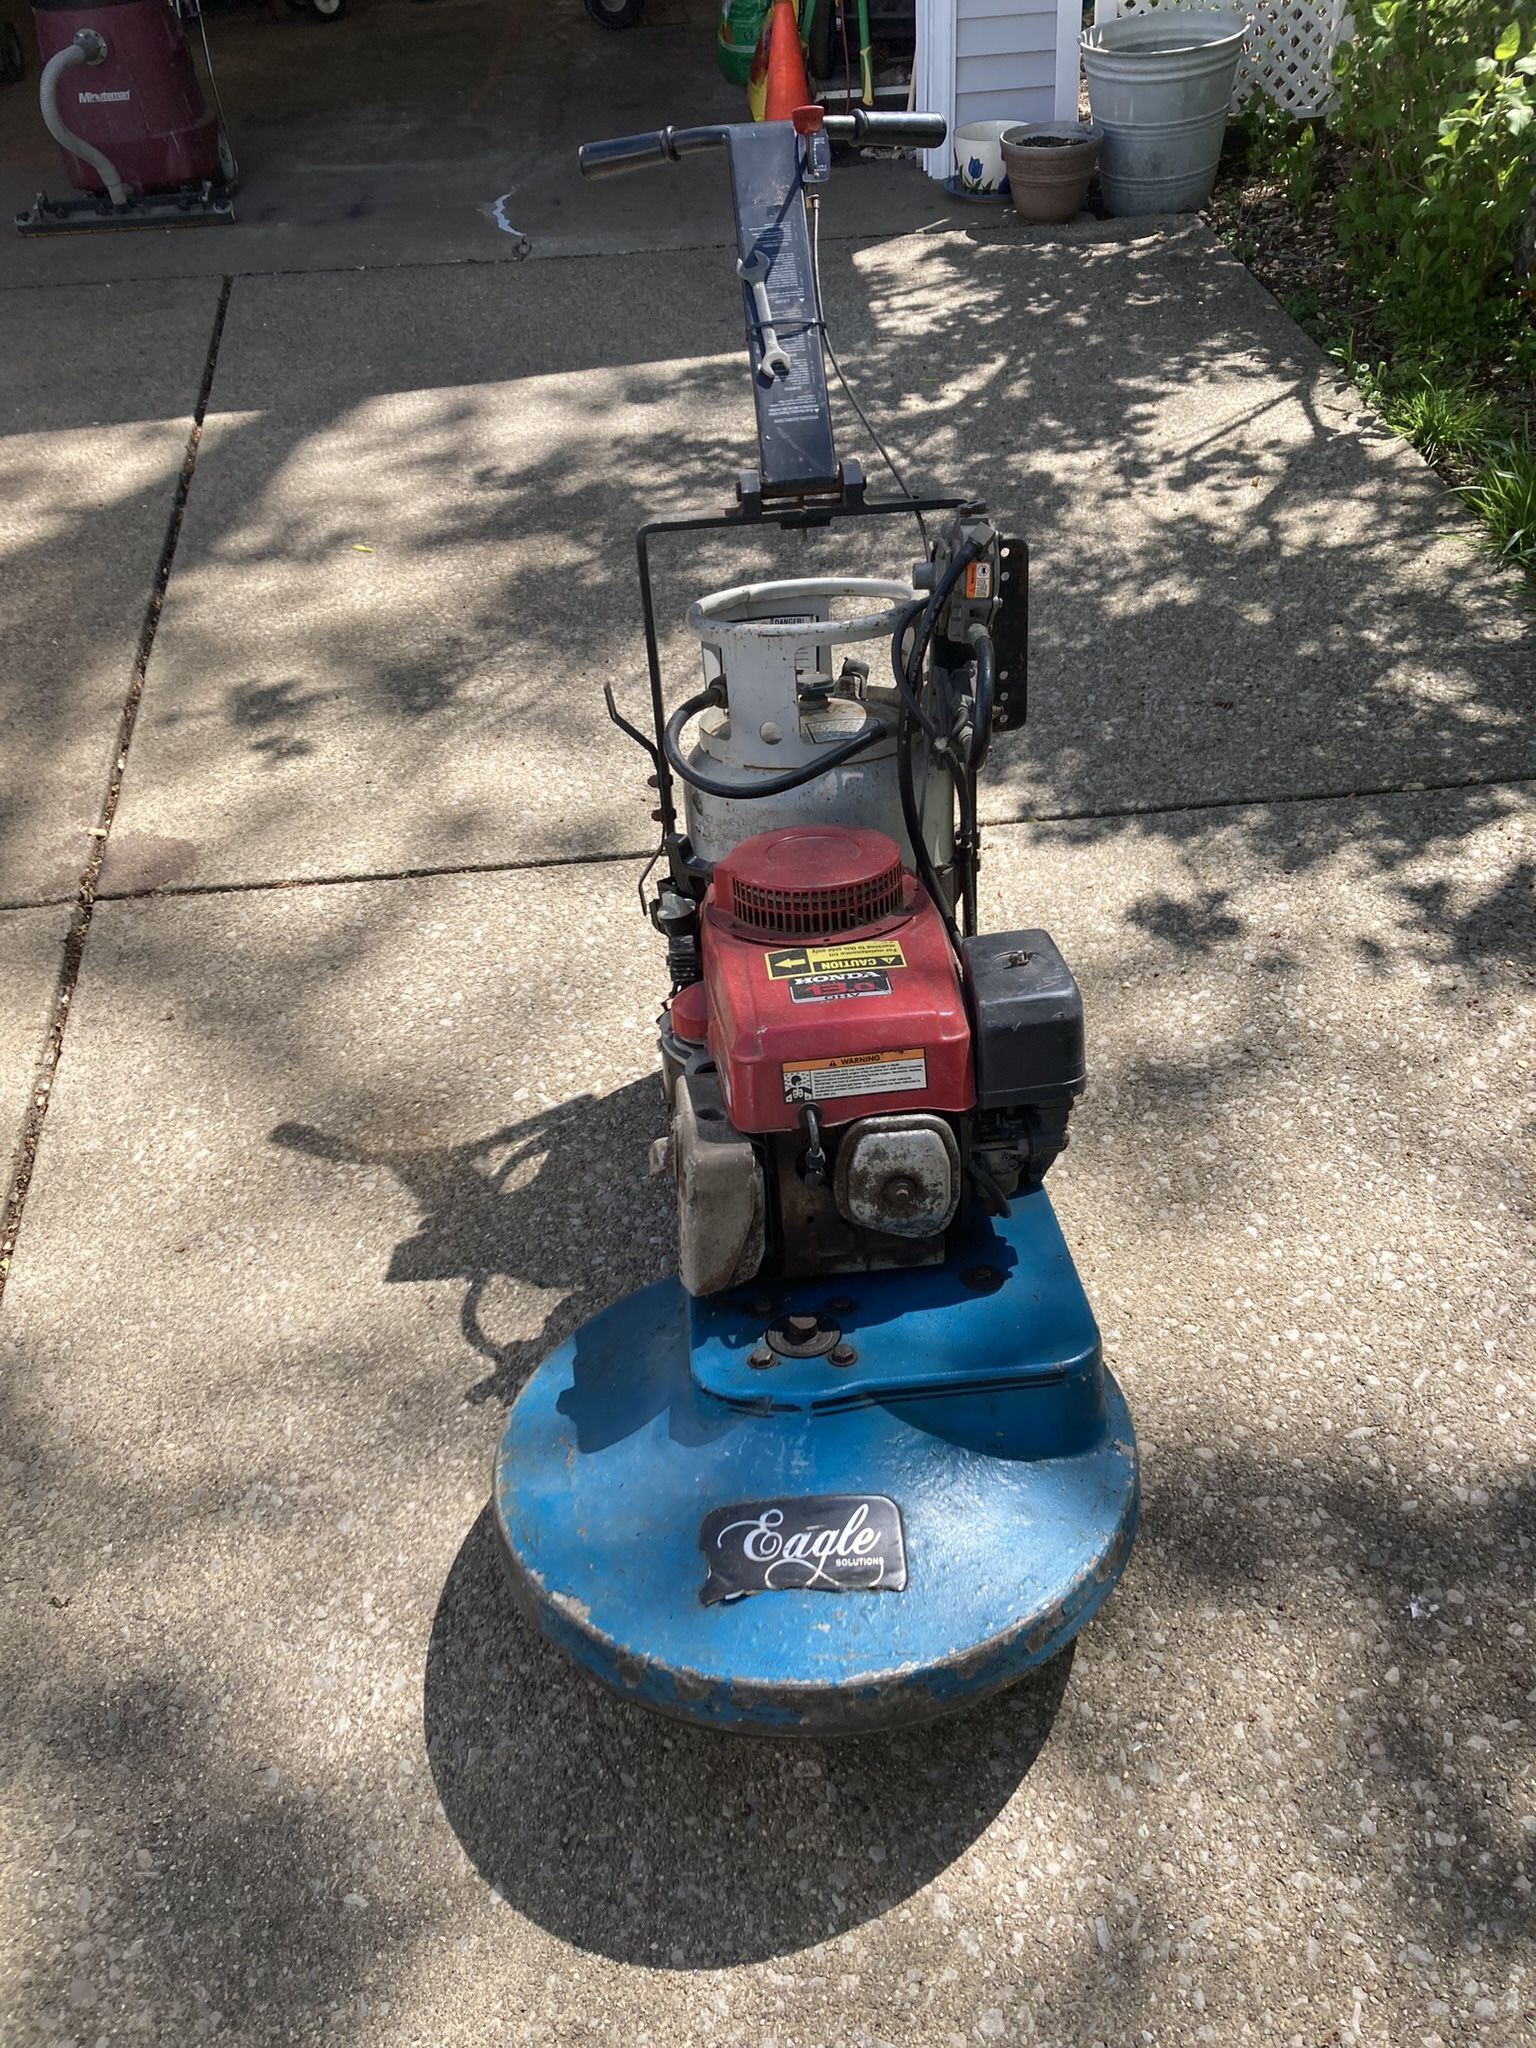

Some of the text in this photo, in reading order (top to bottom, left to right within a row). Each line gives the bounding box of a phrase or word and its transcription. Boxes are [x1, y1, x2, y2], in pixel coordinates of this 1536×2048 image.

[820, 957, 877, 970] CAUTION
[794, 971, 881, 985] HONDA
[804, 982, 875, 995] 13.0
[840, 1055, 881, 1065] WARNING
[717, 1503, 883, 1588] Eagle
